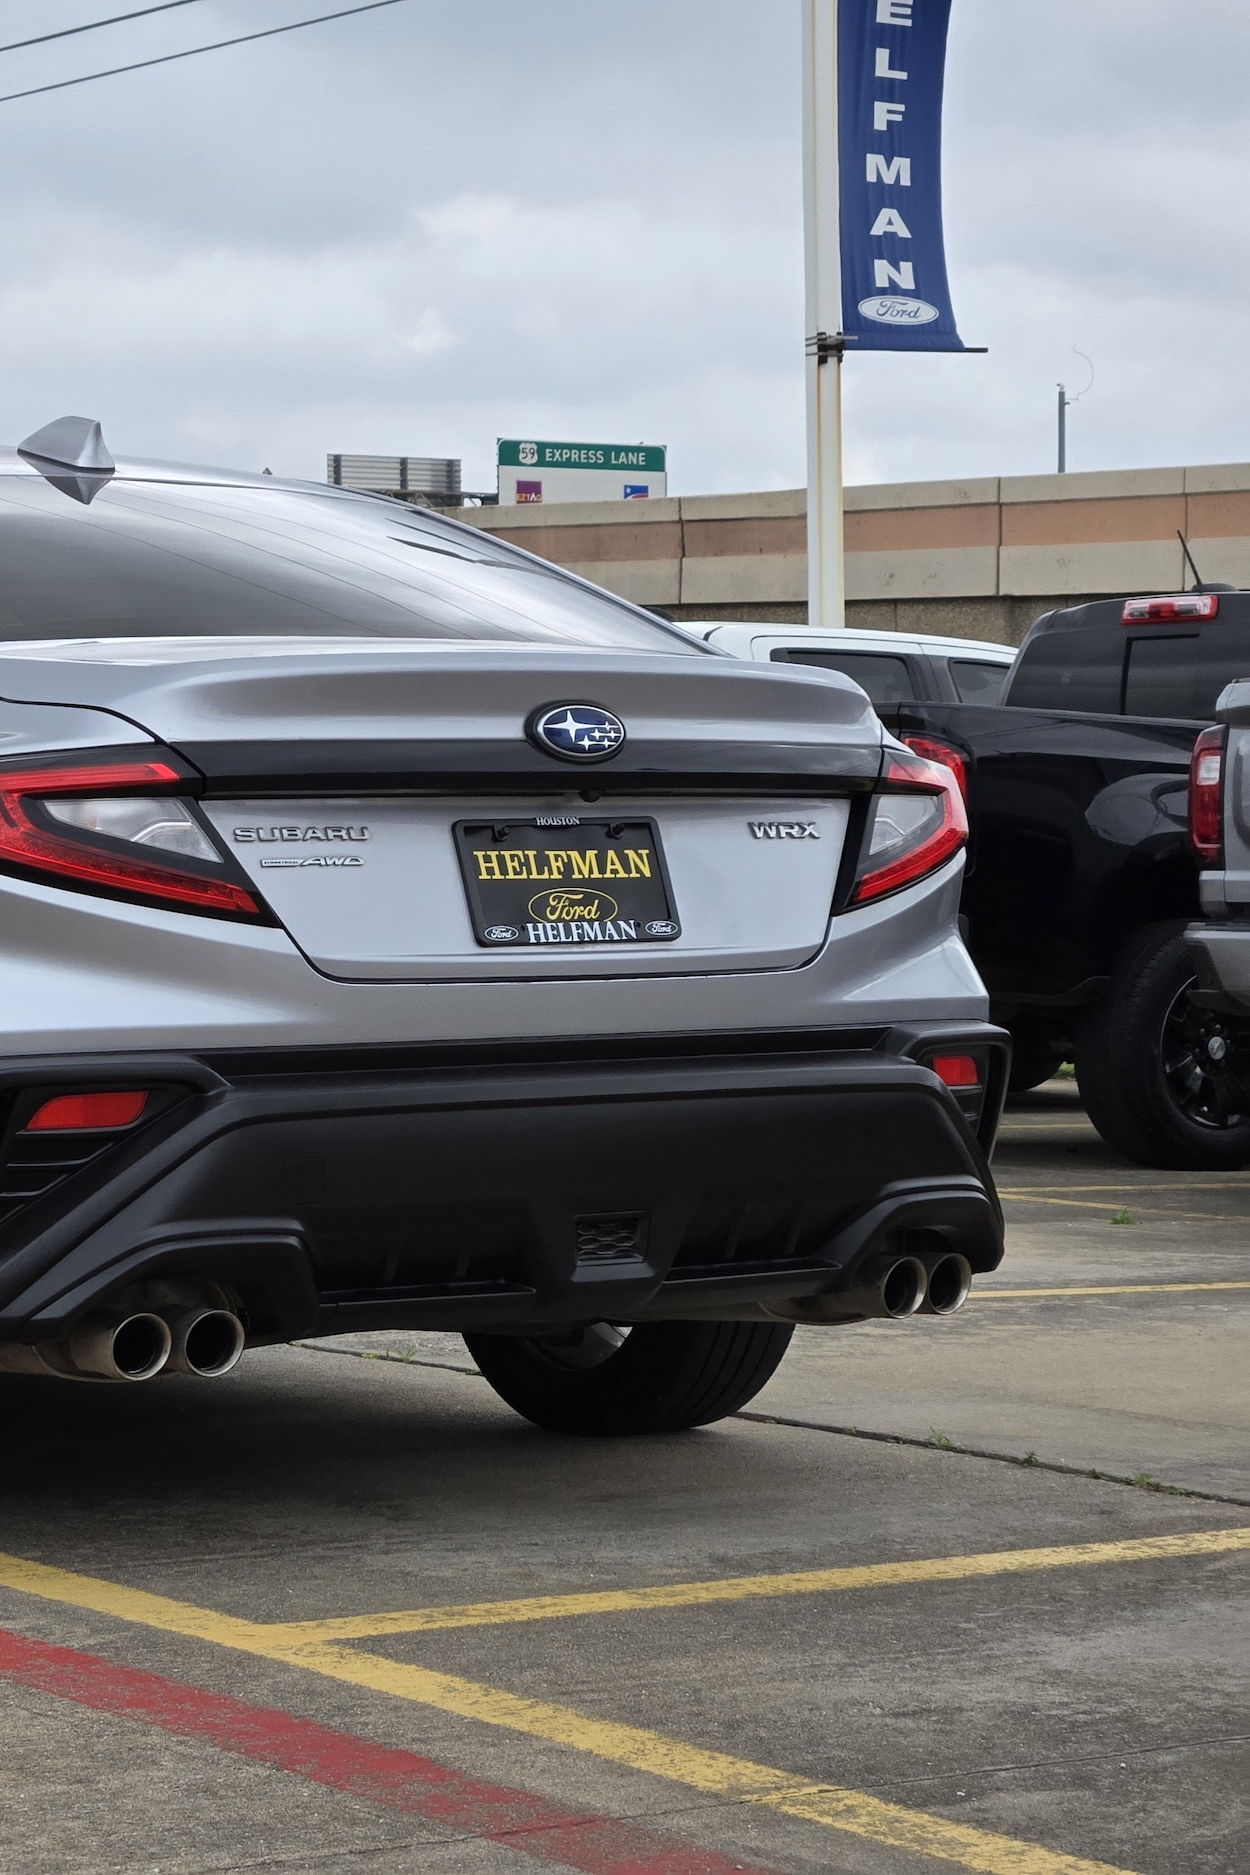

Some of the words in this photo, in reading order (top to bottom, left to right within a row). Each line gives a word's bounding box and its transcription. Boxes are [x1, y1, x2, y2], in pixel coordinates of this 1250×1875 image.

[876, 300, 921, 320] Ford
[521, 447, 536, 459] 59
[545, 448, 605, 464] EXPRESS
[611, 451, 647, 465] LANE
[536, 816, 580, 826] HOUSTON
[747, 821, 821, 839] WRX
[234, 826, 371, 842] SUBARU
[302, 856, 366, 867] AWD
[473, 849, 652, 880] HELFMAN
[546, 893, 601, 920] Ford
[490, 928, 512, 939] Ford
[526, 920, 638, 943] HELFMAN
[651, 922, 673, 934] Ford
